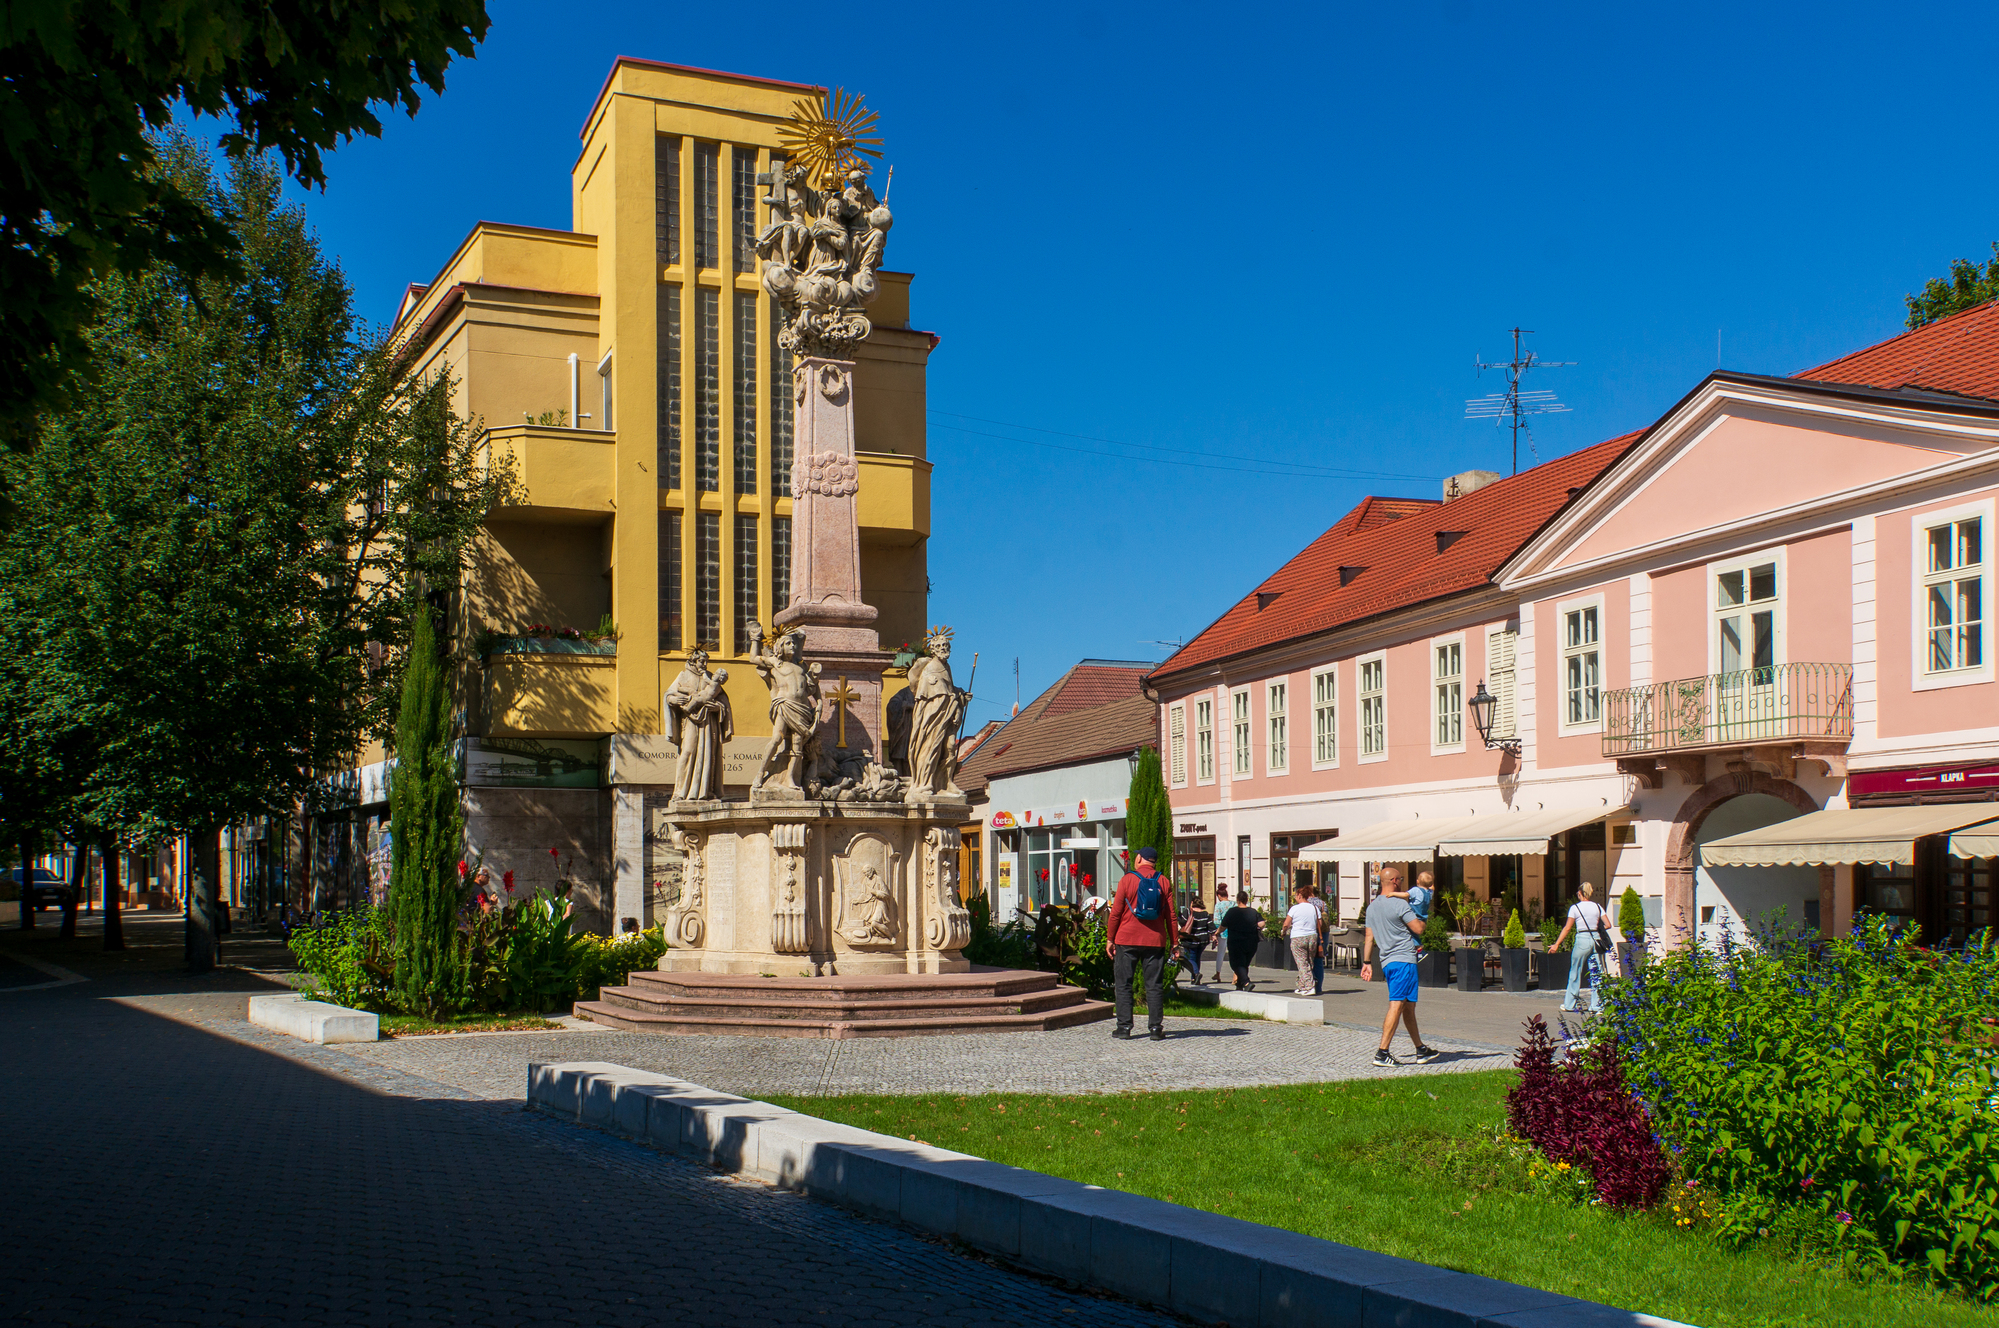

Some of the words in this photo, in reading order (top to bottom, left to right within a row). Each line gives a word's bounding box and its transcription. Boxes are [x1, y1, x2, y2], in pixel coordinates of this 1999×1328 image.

[723, 763, 743, 771] 1265
[1940, 772, 1965, 782] KLAPKA
[995, 816, 1013, 825] teta
